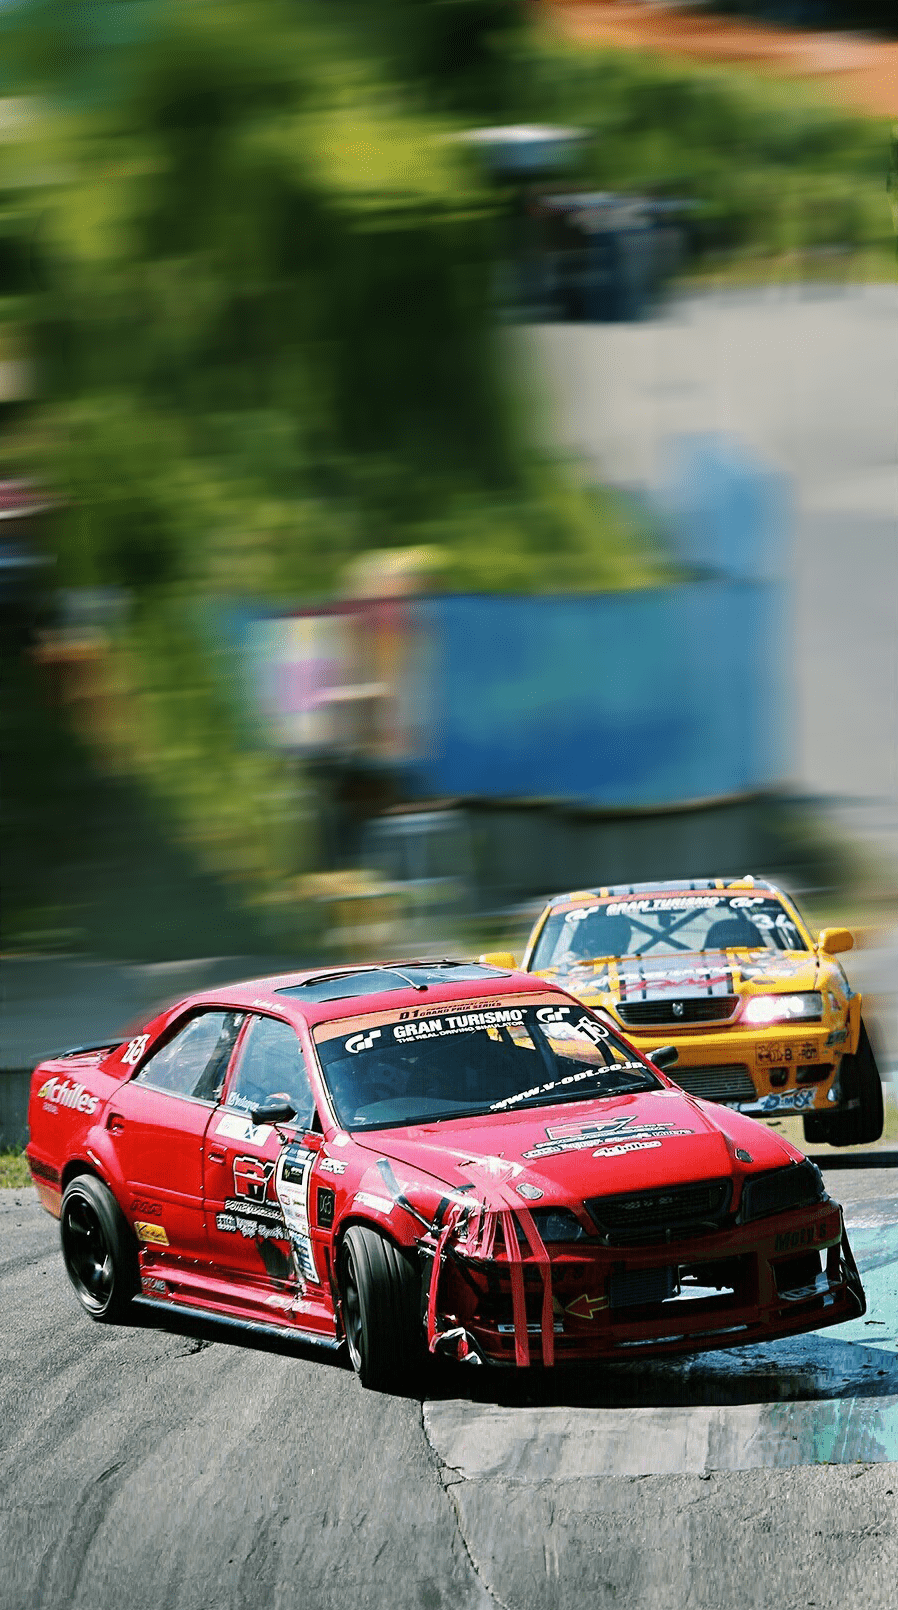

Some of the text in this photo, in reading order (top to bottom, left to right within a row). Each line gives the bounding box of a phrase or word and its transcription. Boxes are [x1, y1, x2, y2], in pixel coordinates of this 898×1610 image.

[606, 899, 651, 916] GRAN
[393, 1009, 523, 1039] GRAN TURISMO
[396, 1020, 525, 1044] THE REAL DRIVING SIMULATOR
[37, 1076, 99, 1115] Achilles
[489, 1061, 648, 1111] www.v-opt.co.jp
